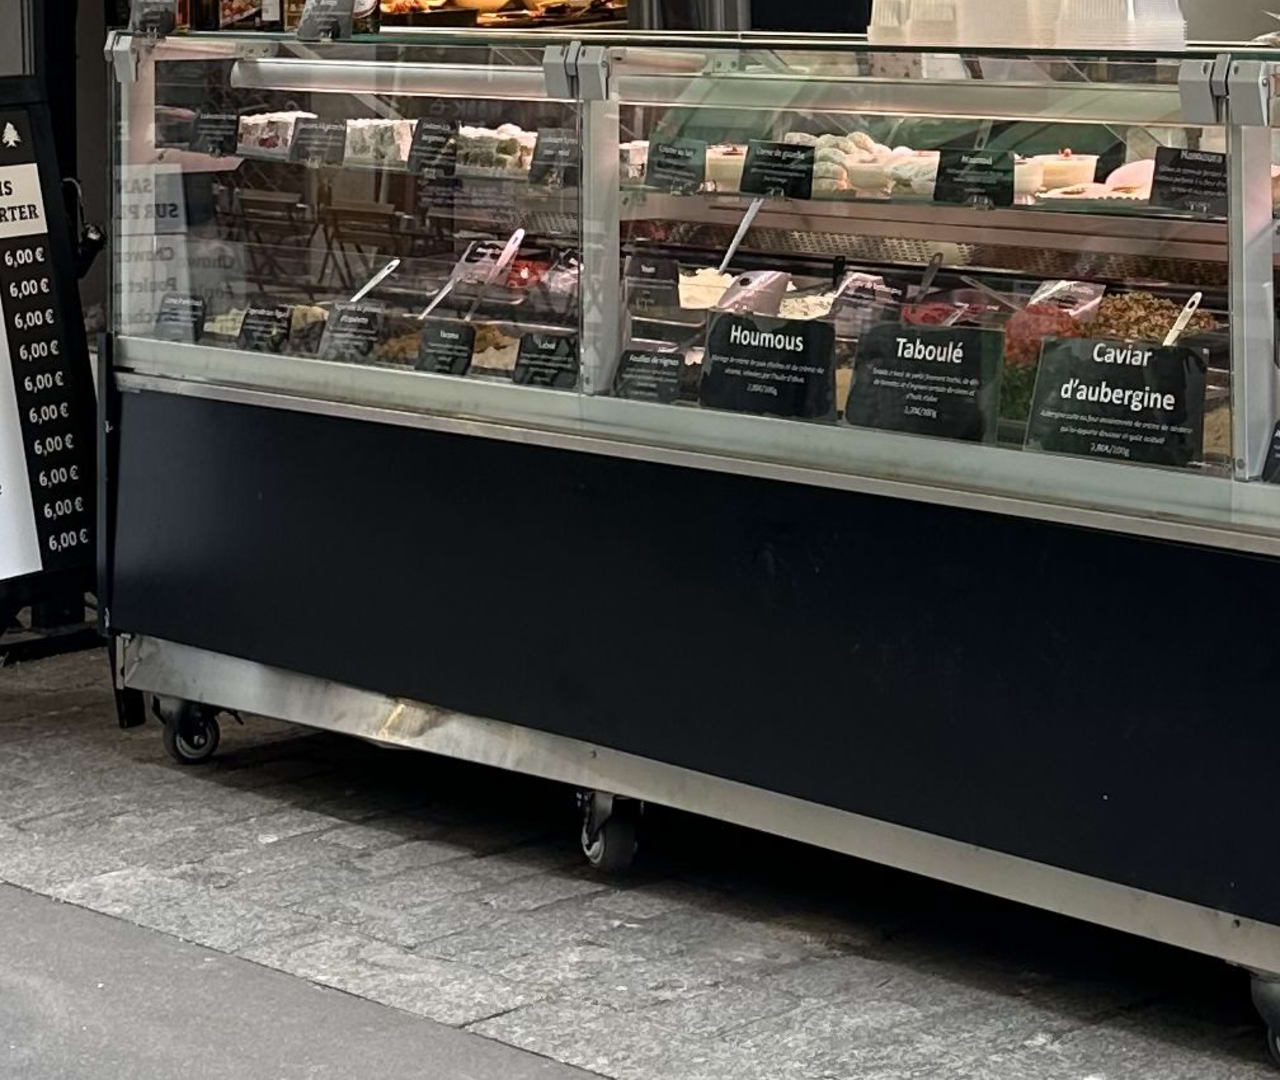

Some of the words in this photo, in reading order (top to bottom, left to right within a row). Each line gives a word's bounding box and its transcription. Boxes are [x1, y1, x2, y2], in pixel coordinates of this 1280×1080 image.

[4, 249, 32, 267] 6,00
[34, 247, 45, 262] €
[9, 280, 38, 298] 6,00
[39, 278, 50, 293] €
[14, 311, 42, 329] 6,00
[44, 309, 55, 324] €
[730, 324, 804, 352] Houmous
[19, 342, 48, 360] 6,00
[49, 340, 60, 355] €
[896, 337, 964, 364] Taboulé
[1092, 342, 1153, 367] Caviar
[24, 374, 53, 392] 6,00
[54, 372, 64, 387] €
[29, 406, 58, 424] 6,00
[59, 402, 70, 418] €
[34, 436, 62, 455] 6,00
[64, 434, 74, 449] €
[38, 468, 68, 486] 6,00
[69, 466, 79, 481] €
[44, 500, 72, 518] 6,00
[74, 497, 84, 512] €
[48, 532, 77, 551] 6,00
[78, 528, 88, 544] €
